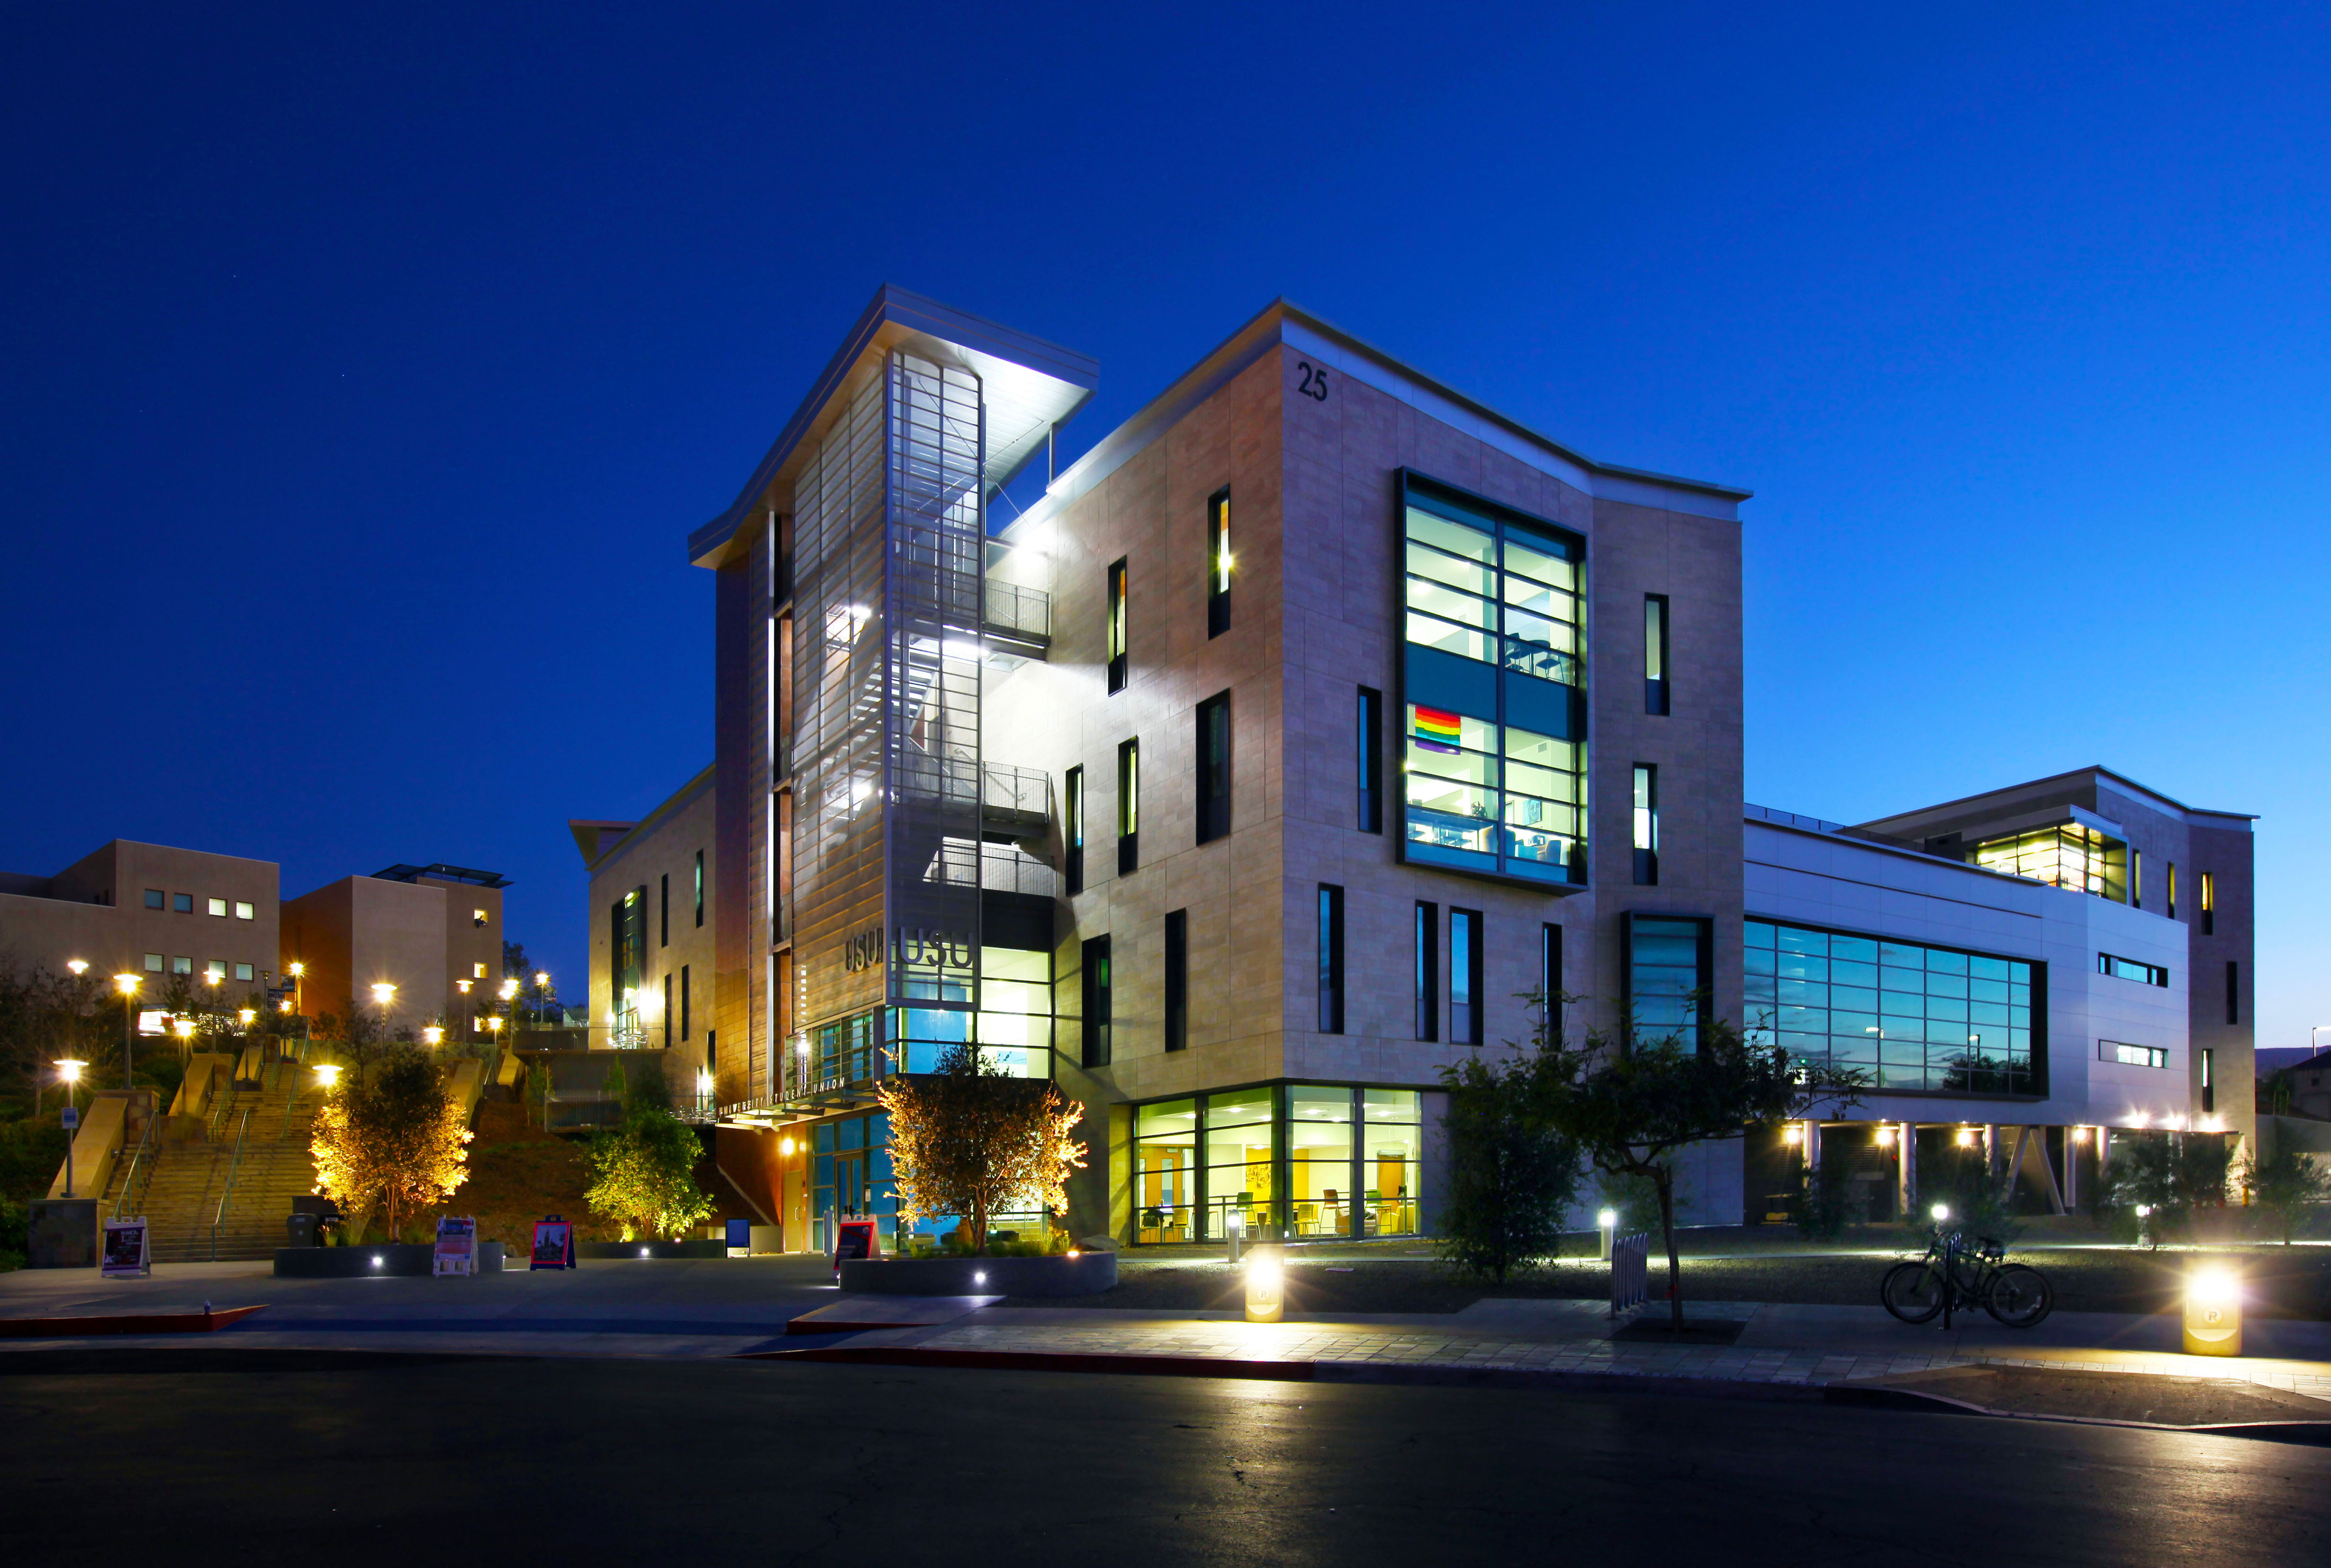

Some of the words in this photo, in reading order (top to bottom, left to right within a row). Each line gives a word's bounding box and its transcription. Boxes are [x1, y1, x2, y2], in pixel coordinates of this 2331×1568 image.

[1298, 361, 1327, 402] 25
[844, 928, 878, 973] USU
[901, 926, 973, 969] USU
[718, 1097, 764, 1115] UNIVERSITY
[769, 1083, 806, 1104] STUDENT
[814, 1077, 844, 1093] UNION
